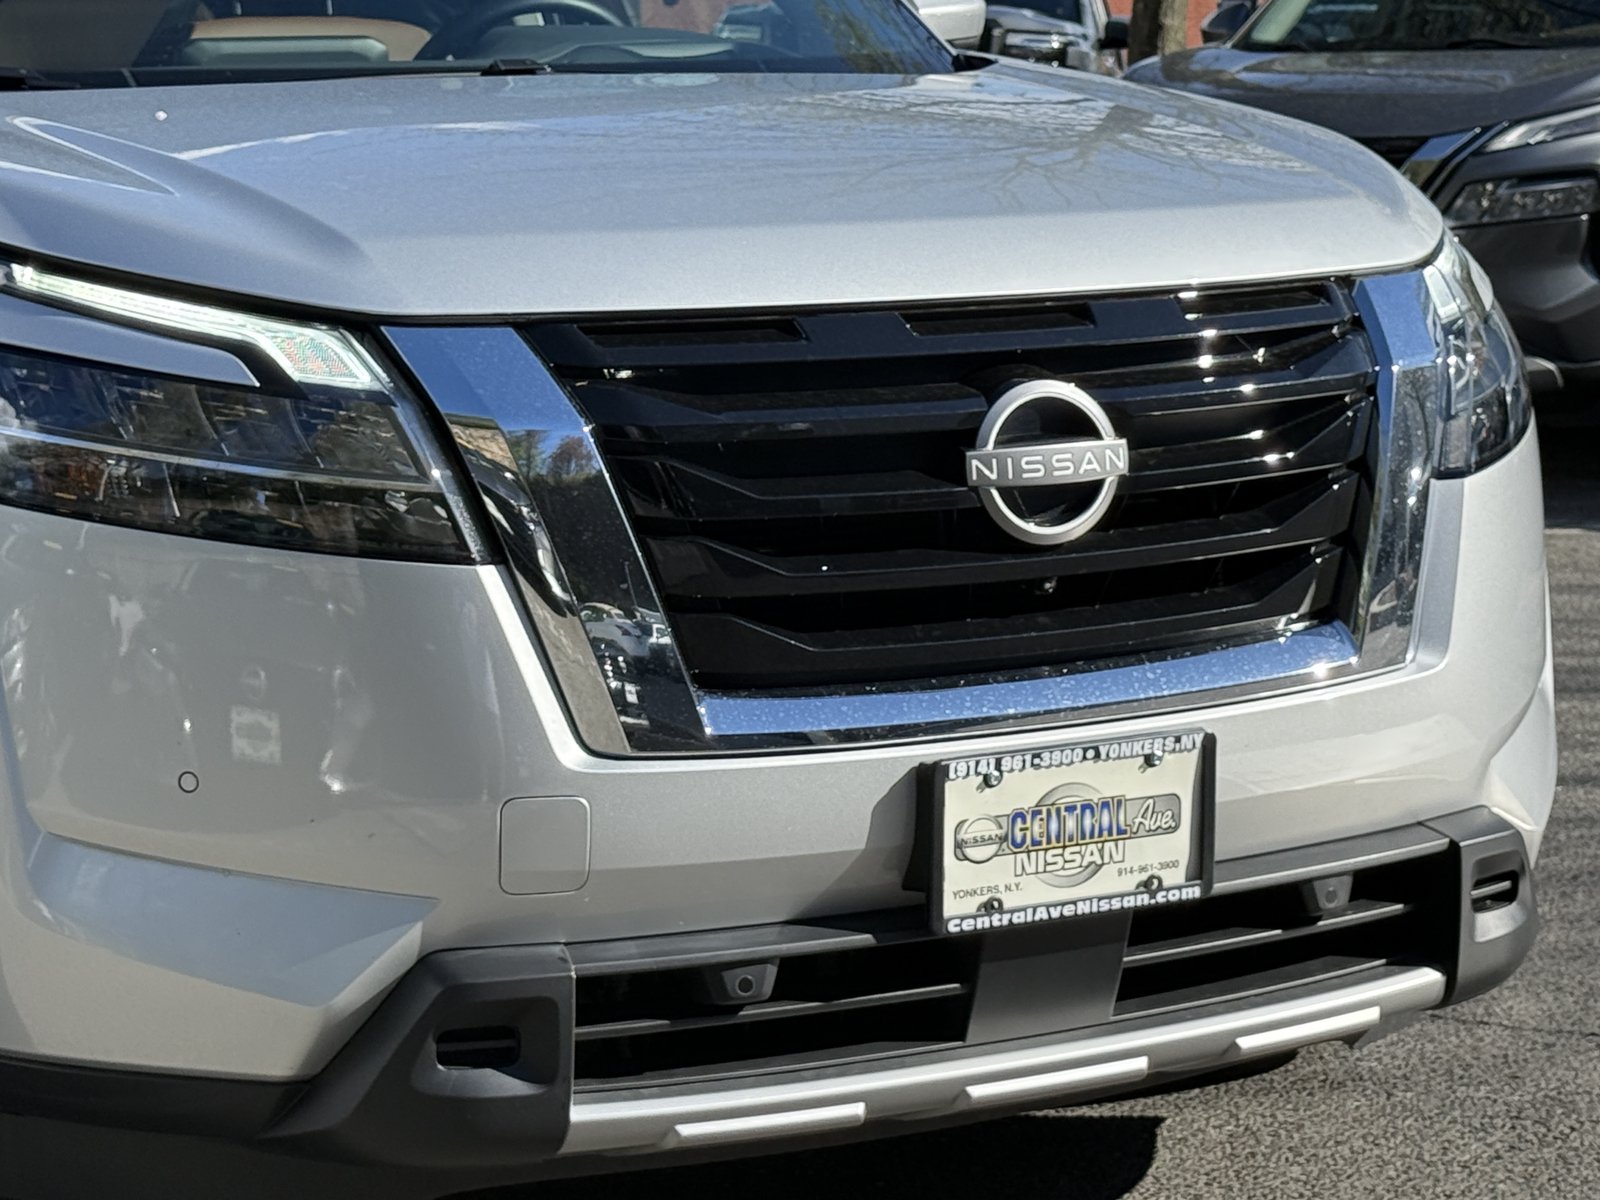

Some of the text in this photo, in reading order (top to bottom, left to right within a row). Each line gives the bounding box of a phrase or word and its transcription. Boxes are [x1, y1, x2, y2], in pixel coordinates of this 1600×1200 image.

[971, 448, 1125, 480] NISSAN
[1001, 748, 1082, 770] 961-3900
[1008, 796, 1176, 852] CENTRAL Ave.
[960, 833, 1003, 845] NISSAN
[1014, 839, 1125, 877] NISSAN
[1117, 860, 1180, 876] 914-961-3900
[952, 882, 1023, 900] YONKERS, N.Y.
